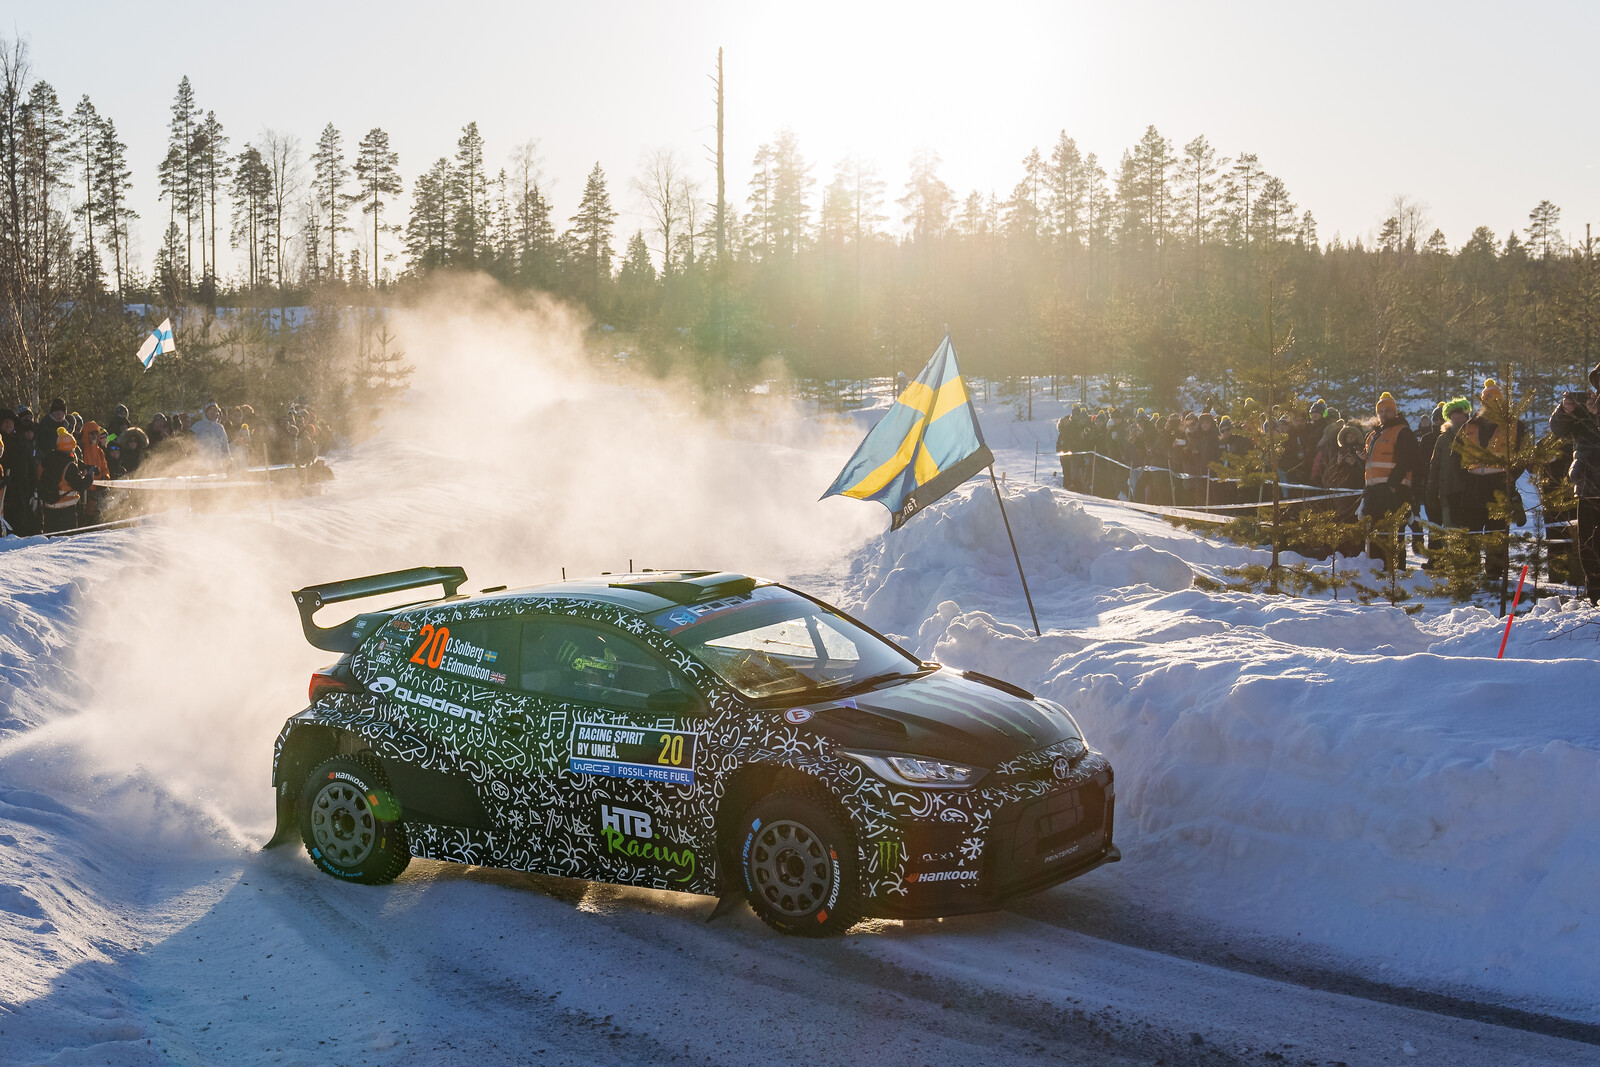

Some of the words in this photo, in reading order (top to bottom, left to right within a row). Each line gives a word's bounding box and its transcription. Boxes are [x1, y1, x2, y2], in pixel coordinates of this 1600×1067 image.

[410, 624, 450, 669] 20
[445, 637, 485, 662] O.Solberg
[439, 655, 491, 681] E.Edmondson
[394, 686, 486, 725] quadrant
[792, 710, 806, 720] E
[578, 727, 614, 741] RACING
[614, 730, 645, 745] SPIRIT
[577, 742, 589, 755] BY
[591, 743, 620, 759] UMEÅ.
[658, 734, 684, 765] 20
[573, 762, 610, 773] WRC2
[618, 766, 668, 780] FOSSIL-FREE
[670, 772, 690, 783] FUEL
[601, 804, 653, 839] HTB
[600, 825, 695, 882] Racing
